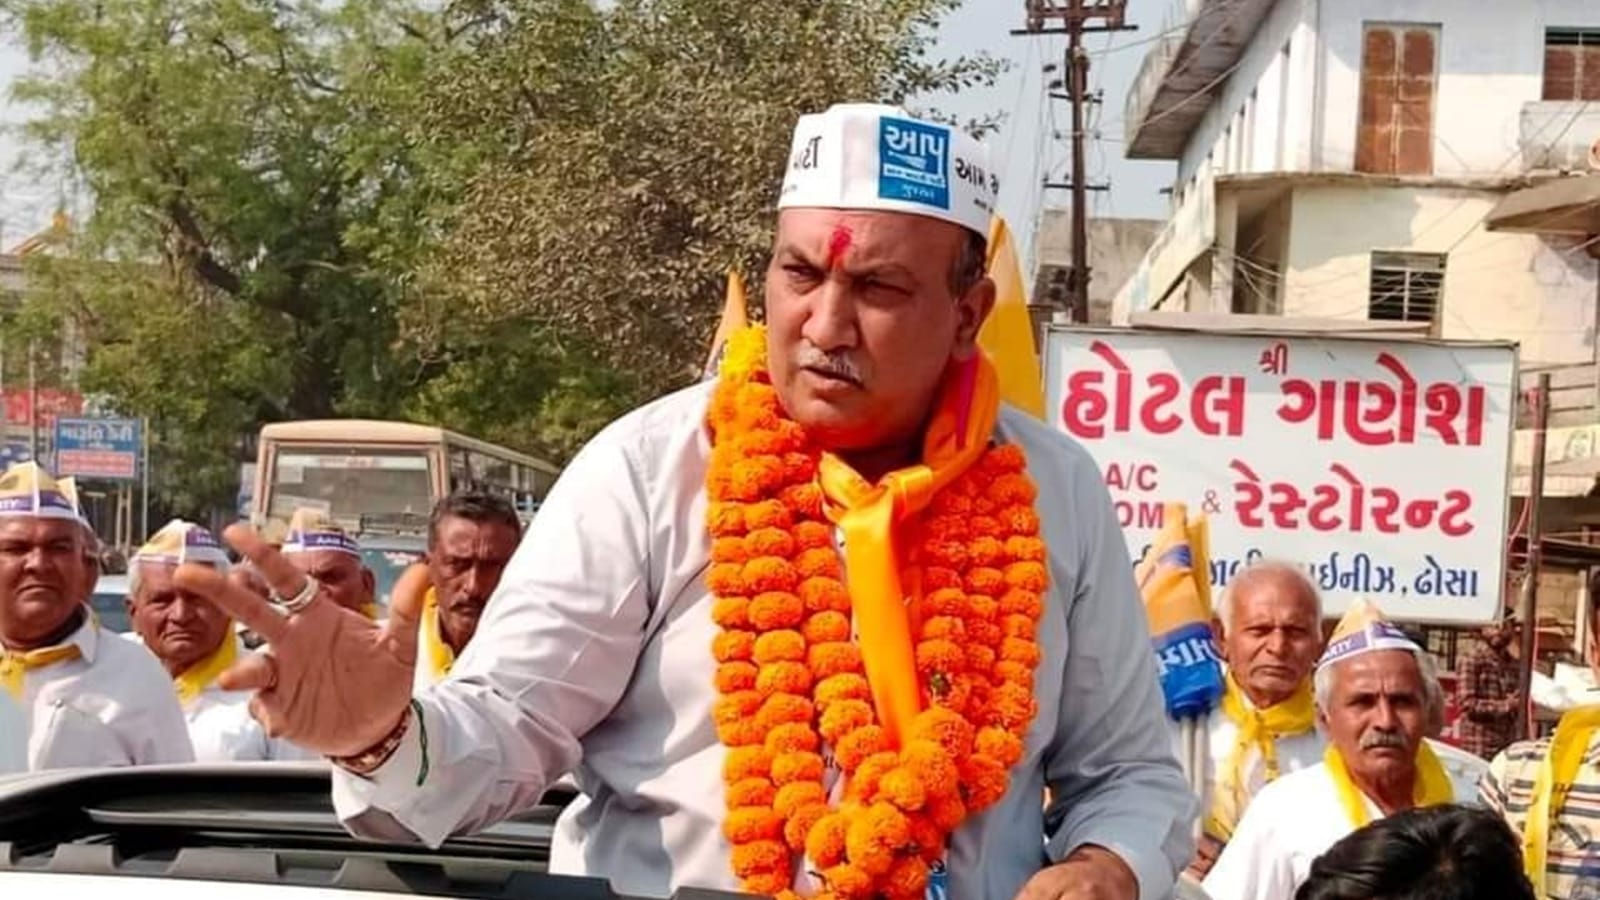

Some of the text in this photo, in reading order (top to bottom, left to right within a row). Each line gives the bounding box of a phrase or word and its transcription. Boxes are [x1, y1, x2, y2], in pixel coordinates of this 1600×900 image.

[885, 124, 945, 171] આપ
[1259, 343, 1288, 375] શ્રી
[1062, 341, 1486, 447] હોટલ ગણેશ
[1105, 462, 1158, 491] A/C
[1114, 501, 1164, 529] OM
[1202, 458, 1475, 537] & રેસ્ટોરન્ટ
[1415, 556, 1477, 596] ઢોસા
